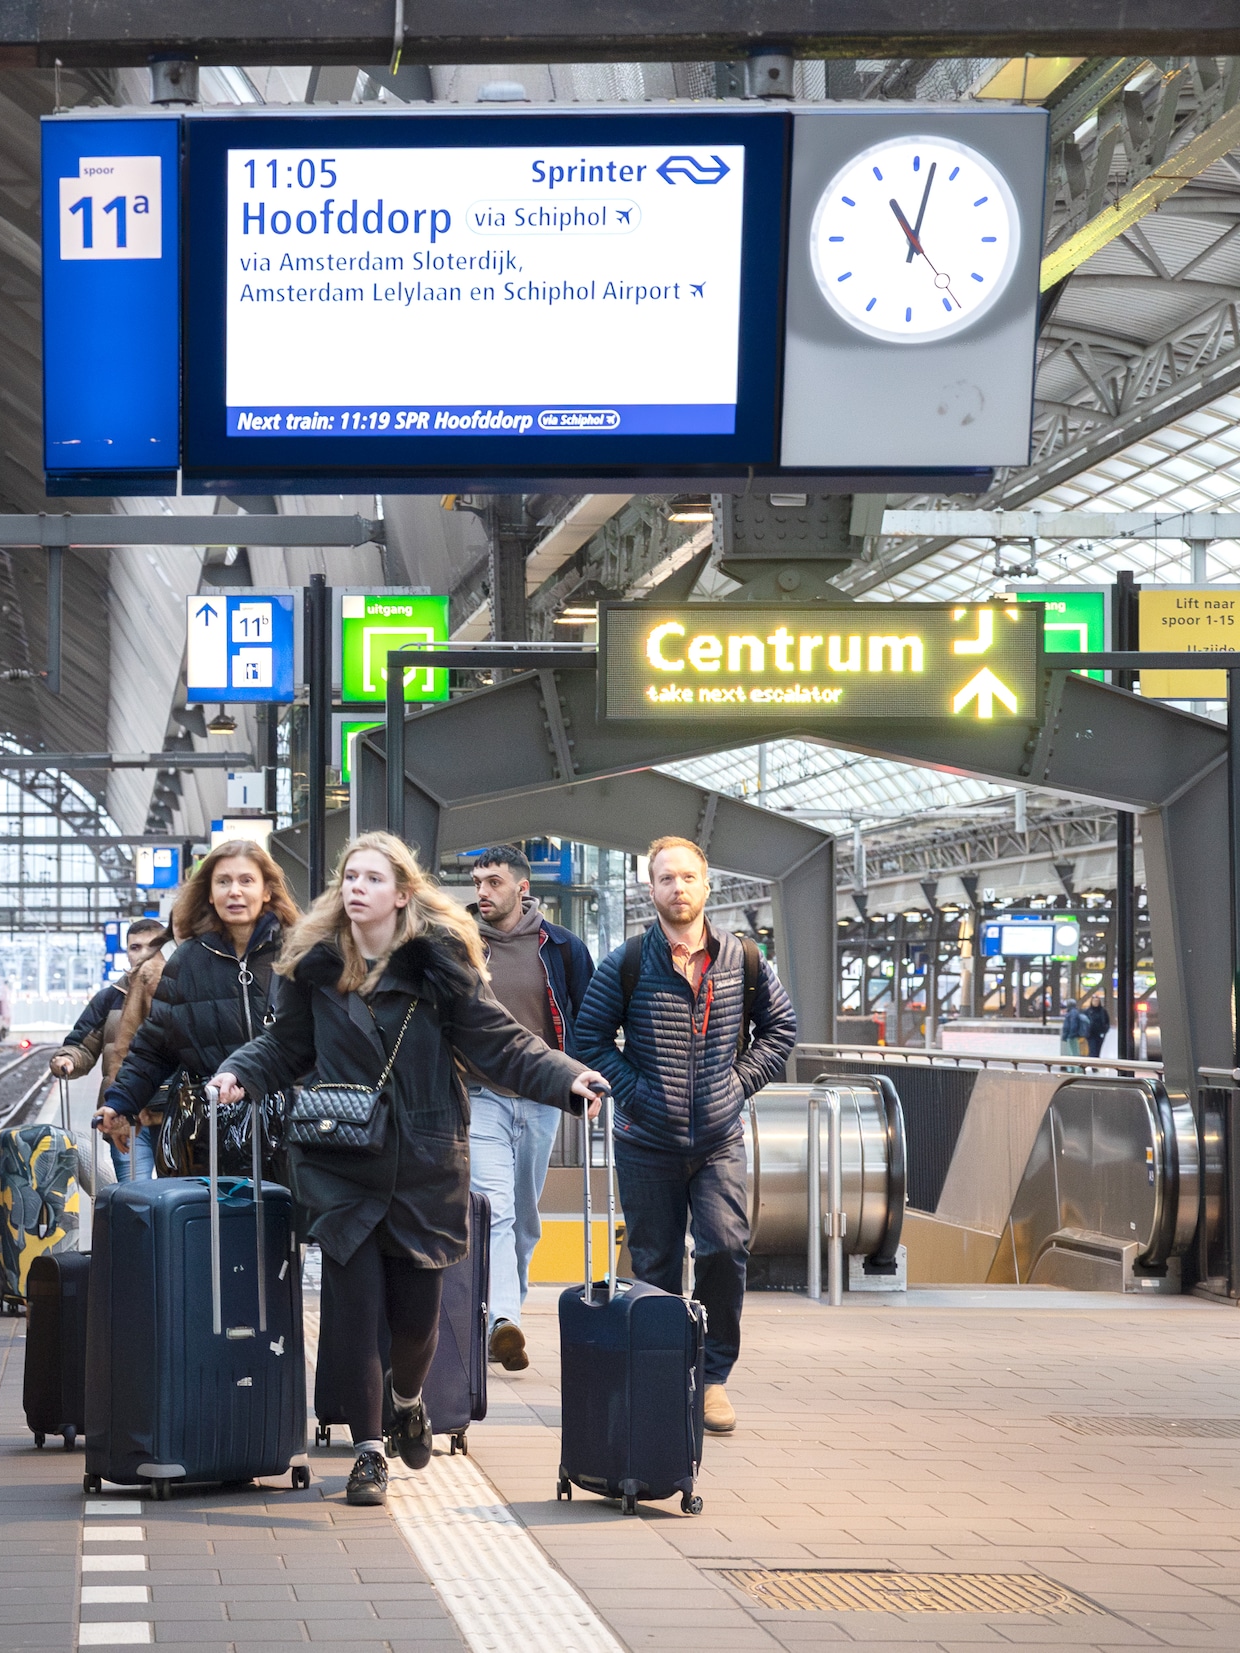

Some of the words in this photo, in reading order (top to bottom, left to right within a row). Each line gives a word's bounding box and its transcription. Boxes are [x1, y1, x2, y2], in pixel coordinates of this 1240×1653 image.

[83, 166, 115, 177] spoor
[243, 157, 338, 189] 11:05
[531, 157, 648, 190] Sprinter
[242, 198, 452, 244] Hoofddorp
[474, 207, 506, 227] via
[514, 205, 607, 232] Schiphol
[239, 252, 271, 272] via
[279, 250, 404, 272] Amsterdam
[412, 249, 524, 276] Sloterdijk,
[239, 281, 365, 303] Amsterdam
[372, 280, 462, 307] Lelylaan
[469, 286, 495, 302] en
[504, 280, 596, 306] Schiphol
[602, 280, 681, 306] Airport
[237, 411, 282, 431] Next
[285, 410, 335, 431] train:
[340, 411, 391, 430] 11:19
[394, 410, 430, 430] SPR
[433, 409, 534, 434] Hoofddorp
[542, 413, 558, 426] via
[560, 412, 604, 427] Schiphol
[367, 603, 413, 618] uitgang
[1176, 597, 1200, 609] Lift
[1204, 600, 1236, 609] naar
[1161, 616, 1201, 628] spoor
[1205, 614, 1235, 626] 1-15
[646, 621, 926, 673] Centrum
[645, 683, 695, 704] take
[698, 684, 747, 704] next
[749, 682, 844, 704] escalator
